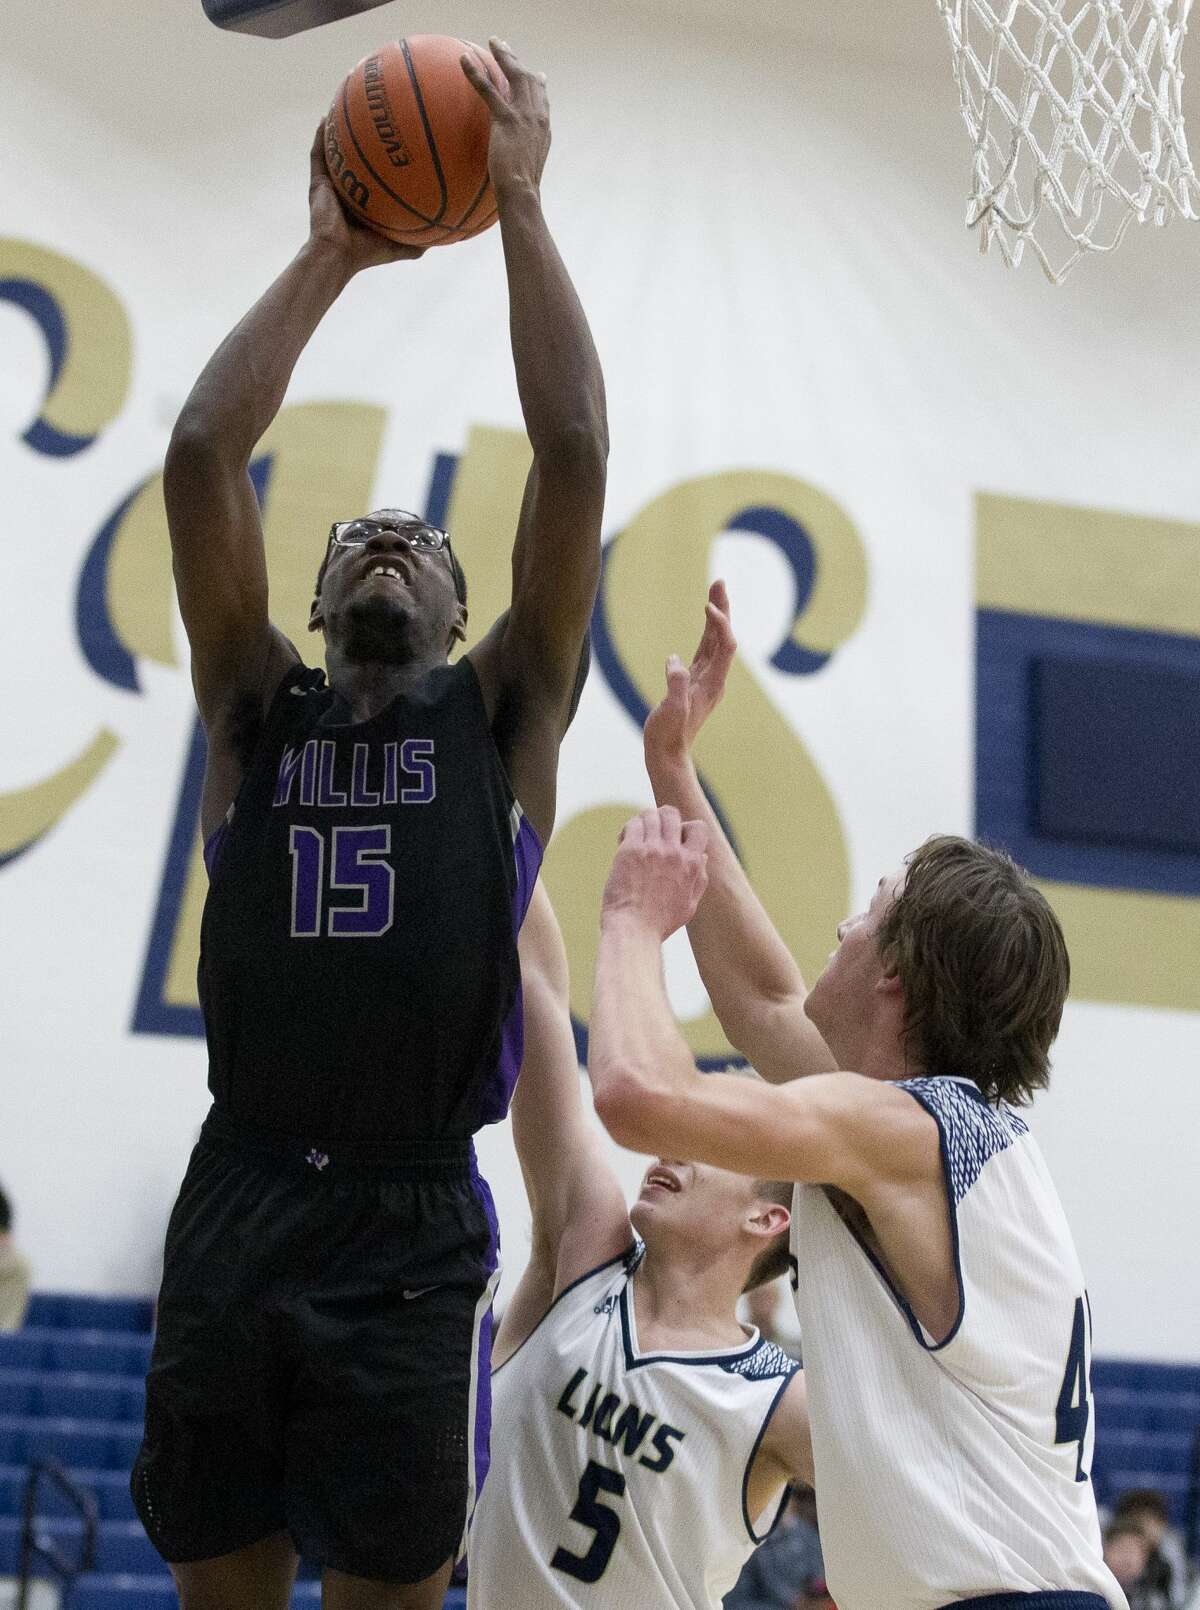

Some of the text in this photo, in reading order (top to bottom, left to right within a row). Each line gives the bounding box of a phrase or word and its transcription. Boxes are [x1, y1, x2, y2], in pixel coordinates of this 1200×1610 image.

[272, 739, 437, 807] WILLIS
[289, 824, 395, 937] 15
[556, 1367, 686, 1474] LIONS
[550, 1459, 626, 1584] 5
